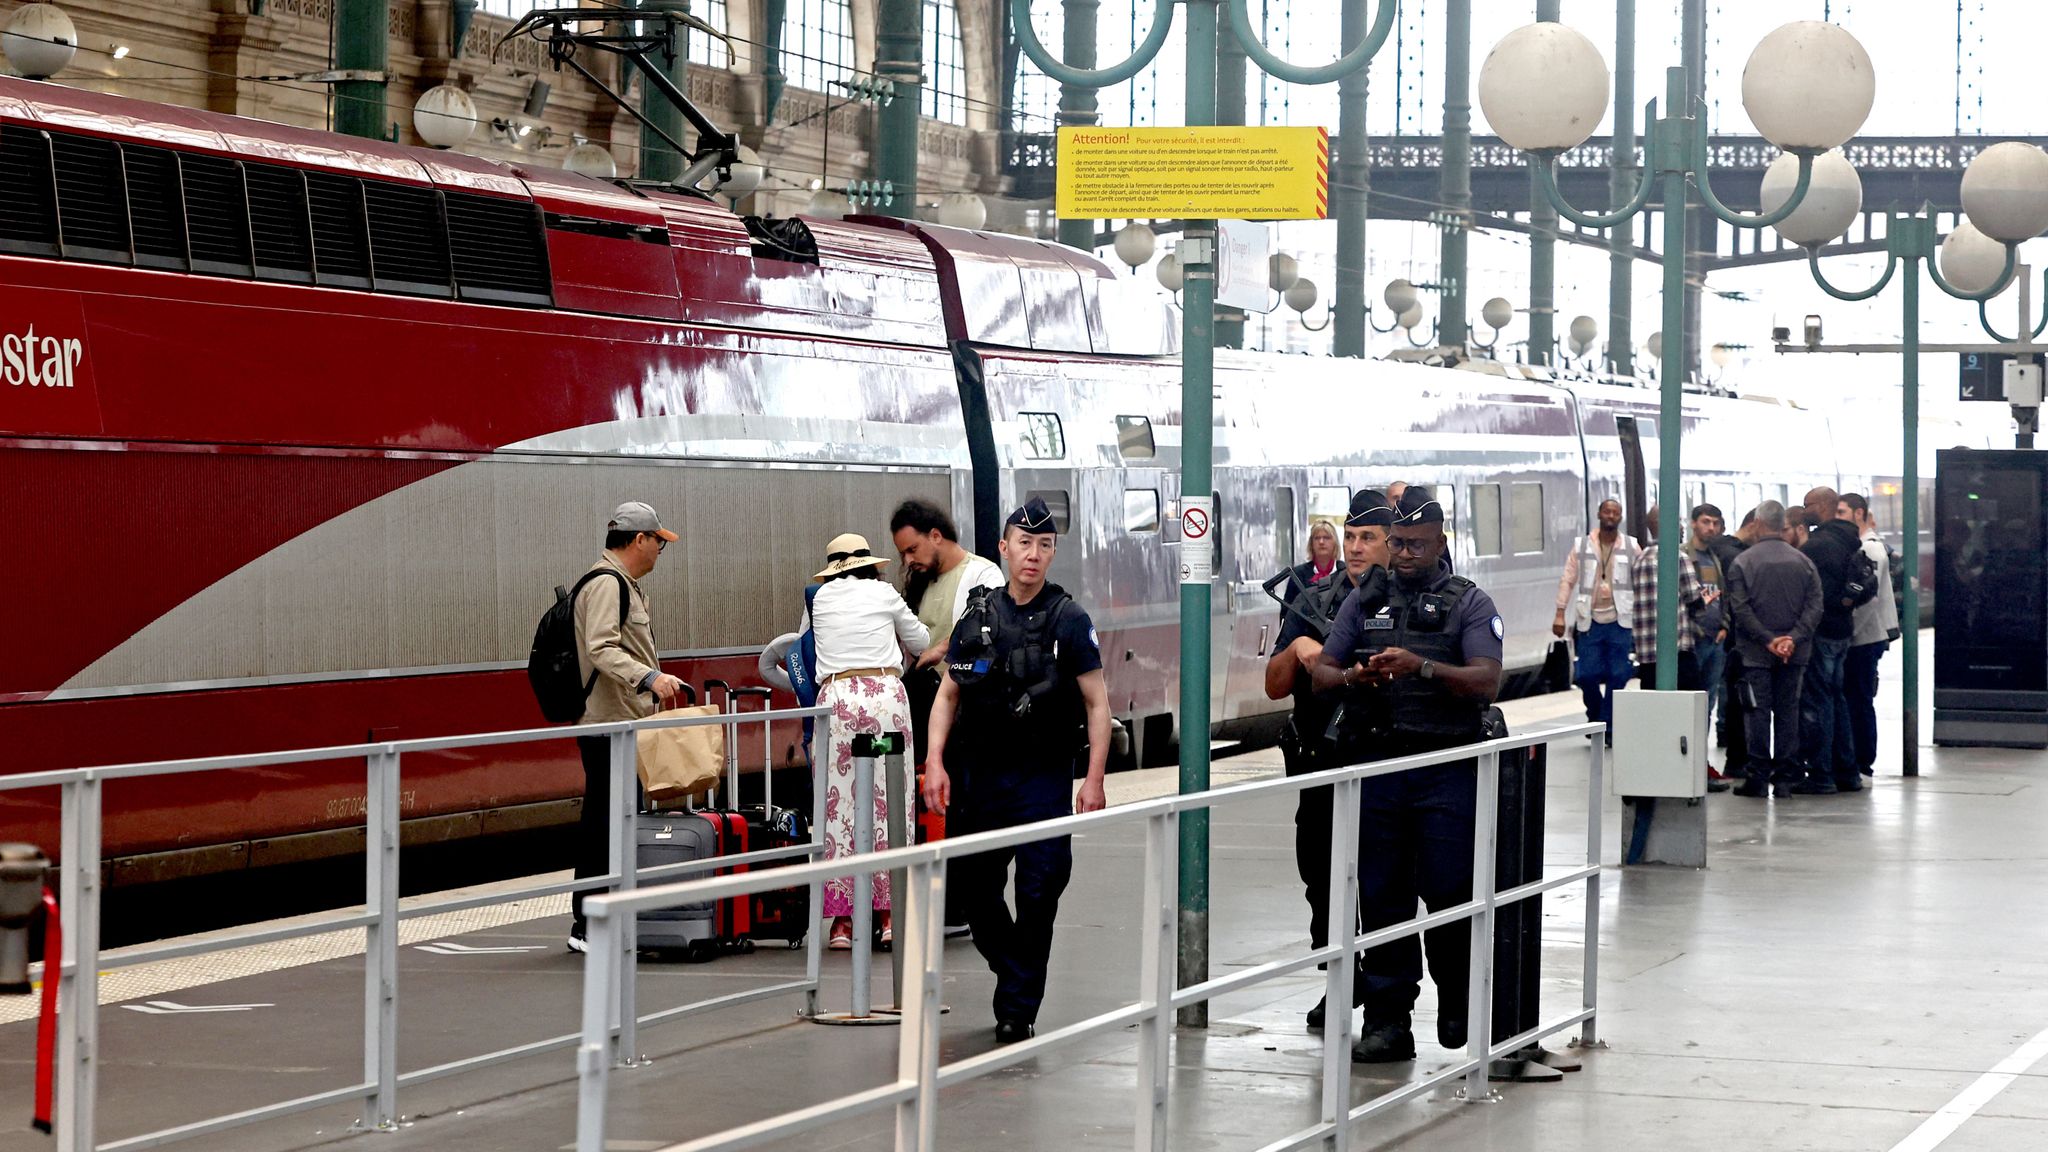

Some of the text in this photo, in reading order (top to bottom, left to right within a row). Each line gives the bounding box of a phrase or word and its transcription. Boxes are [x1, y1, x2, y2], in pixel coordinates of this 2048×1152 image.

[1072, 134, 1130, 144] Attention!
[0, 323, 82, 387] star
[1968, 354, 1978, 368] 9
